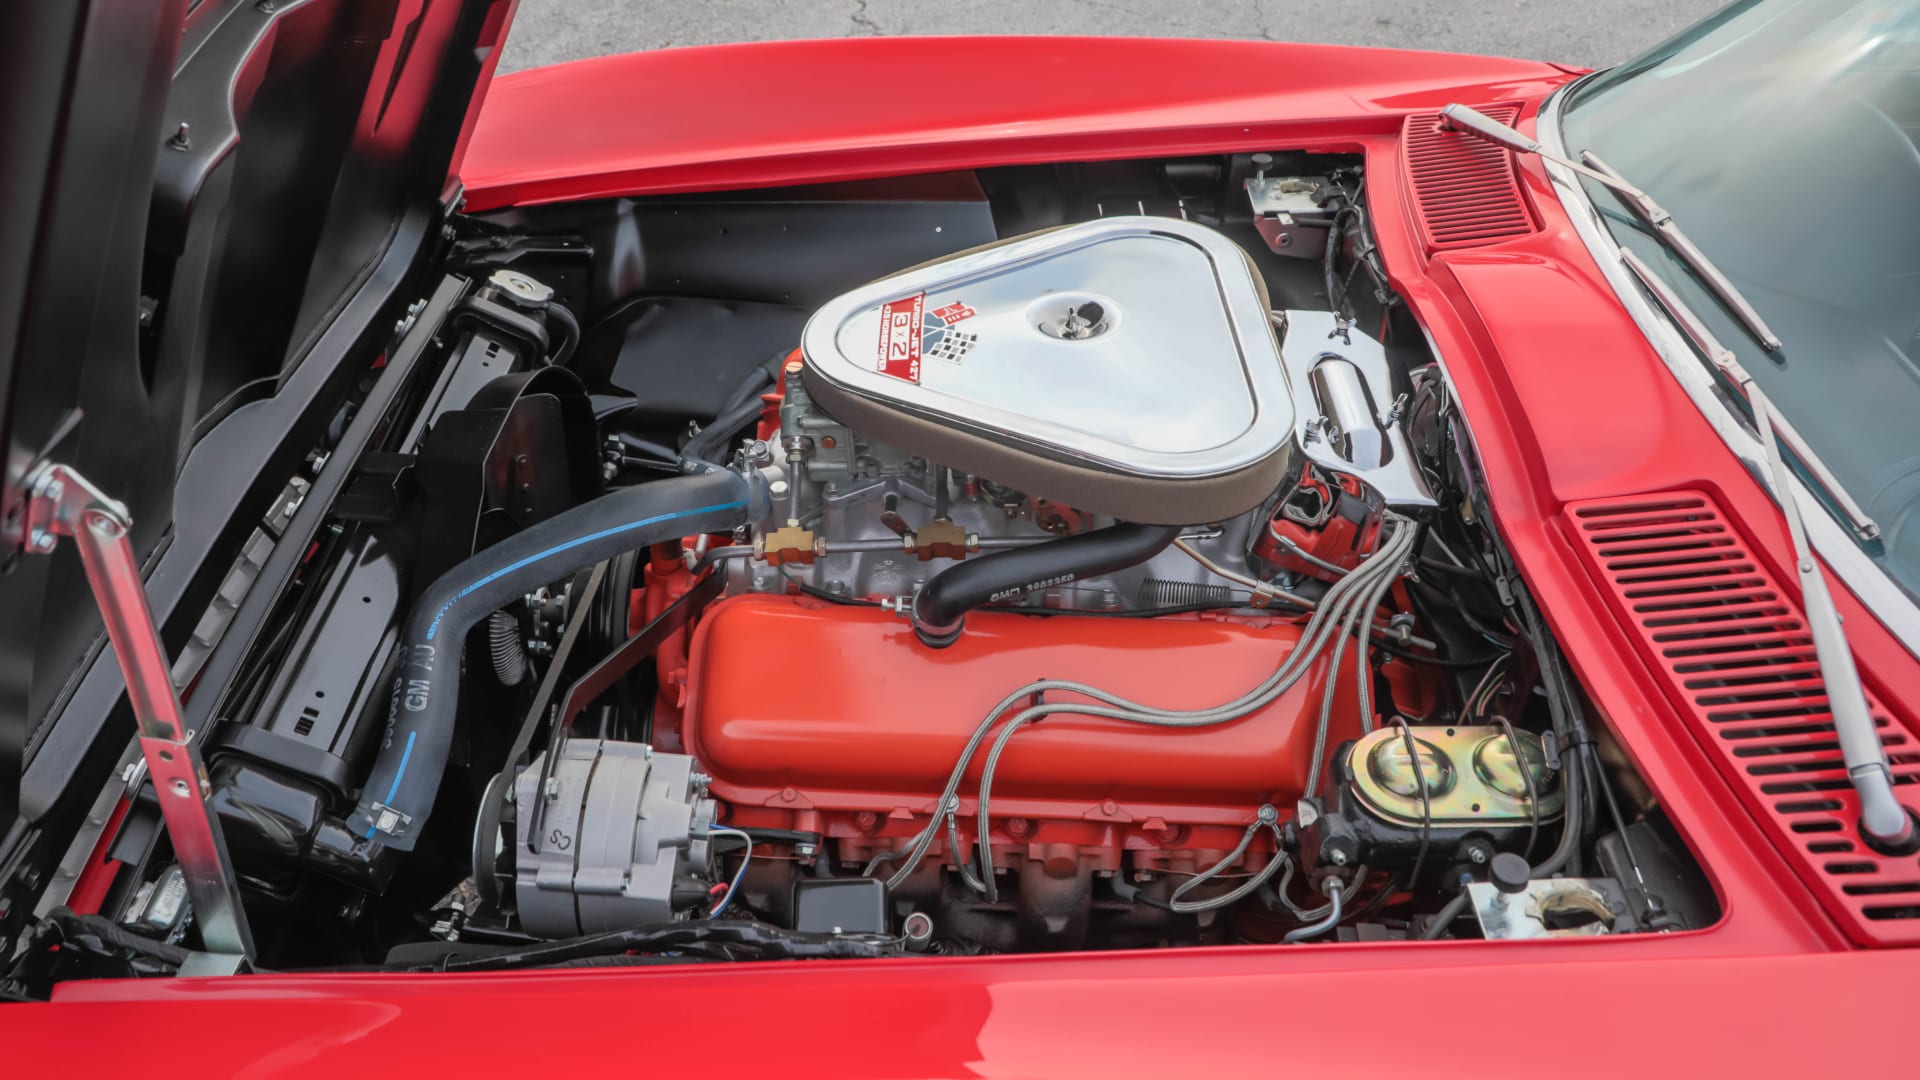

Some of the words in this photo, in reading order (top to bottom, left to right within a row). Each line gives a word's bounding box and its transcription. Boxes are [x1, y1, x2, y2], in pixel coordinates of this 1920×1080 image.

[894, 314, 909, 328] 3
[910, 295, 922, 358] TURBO-JET
[892, 341, 907, 357] 2
[909, 360, 919, 380] 427
[404, 679, 431, 712] GM
[550, 829, 571, 850] CS
